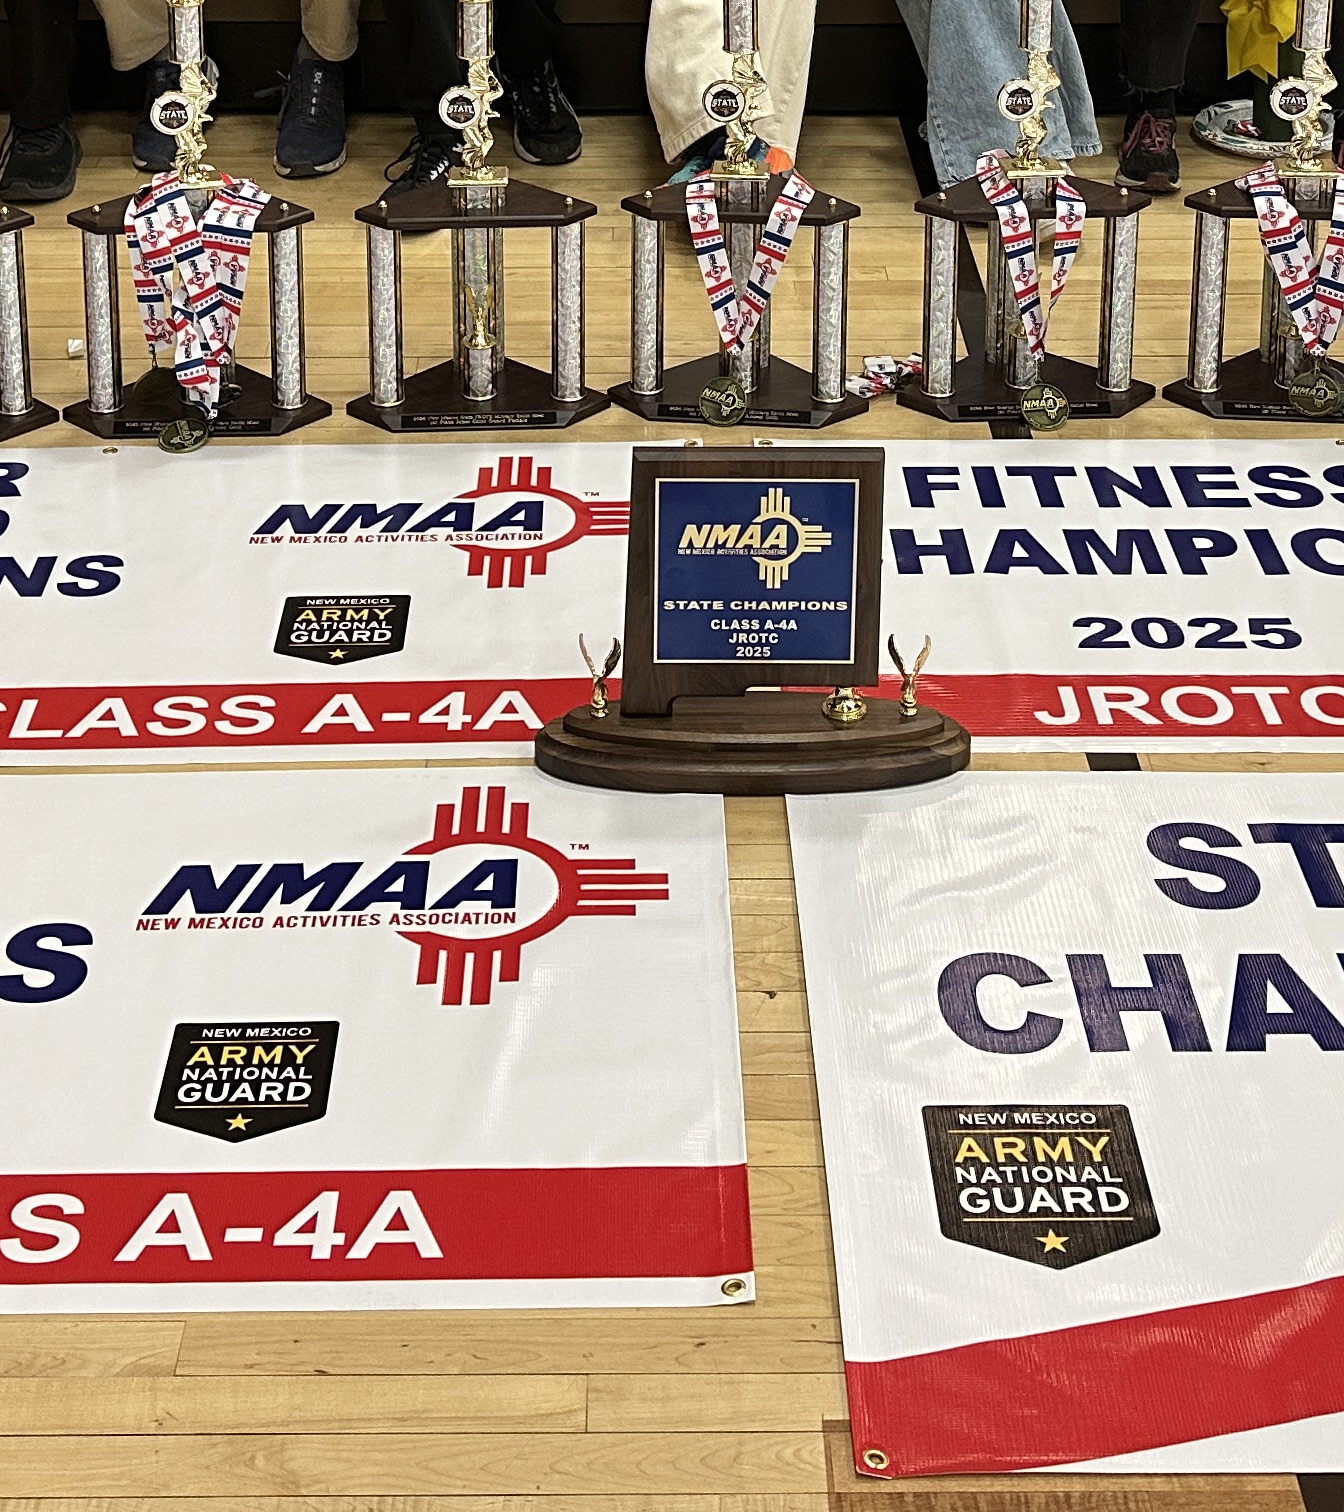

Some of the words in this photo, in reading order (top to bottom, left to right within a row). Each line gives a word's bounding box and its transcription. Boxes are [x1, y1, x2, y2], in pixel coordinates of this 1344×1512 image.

[711, 99, 737, 107] STATE
[1006, 97, 1032, 105] STATE
[1280, 97, 1306, 106] STATE
[160, 110, 187, 119] STATE
[448, 105, 474, 113] STATE
[703, 387, 734, 406] NMAA
[1291, 384, 1327, 399] NMAA
[1023, 398, 1055, 410] NMAA
[251, 501, 545, 535] NMAA
[249, 534, 283, 544] NEW
[288, 533, 348, 544] MEXICO
[353, 532, 440, 544] ACTIVITIES
[444, 531, 544, 543] ASSOCIATION
[678, 524, 788, 548] NMAA
[306, 598, 336, 606] NEW
[339, 597, 391, 606] MEXICO
[663, 600, 724, 610] STATE
[730, 600, 848, 611] CHAMPIONS
[295, 607, 394, 622] ARMY
[292, 620, 393, 632] NATIONAL
[710, 619, 760, 630] CLASS
[764, 619, 798, 630] A-4A
[288, 628, 392, 645] GUARD
[728, 633, 779, 644] JROTC
[1073, 616, 1303, 650] 2025
[735, 646, 771, 657] 2025
[300, 691, 544, 734] A-4A
[141, 858, 518, 915] NMAA
[136, 916, 181, 931] NEW
[186, 915, 264, 931] MEXICO
[272, 913, 382, 929] ACTIVITIES
[389, 910, 517, 926] ASSOCIATION
[202, 1028, 239, 1038] NEW
[245, 1026, 312, 1038] MEXICO
[186, 1043, 316, 1066] ARMY
[181, 1065, 314, 1083] NATIONAL
[176, 1079, 313, 1106] GUARD
[958, 1112, 1009, 1125] NEW
[1014, 1111, 1097, 1125] MEXICO
[954, 1136, 1111, 1164] ARMY
[956, 1164, 1123, 1185] NATIONAL
[958, 1185, 1130, 1214] GUARD
[114, 1188, 444, 1263] A-4A
